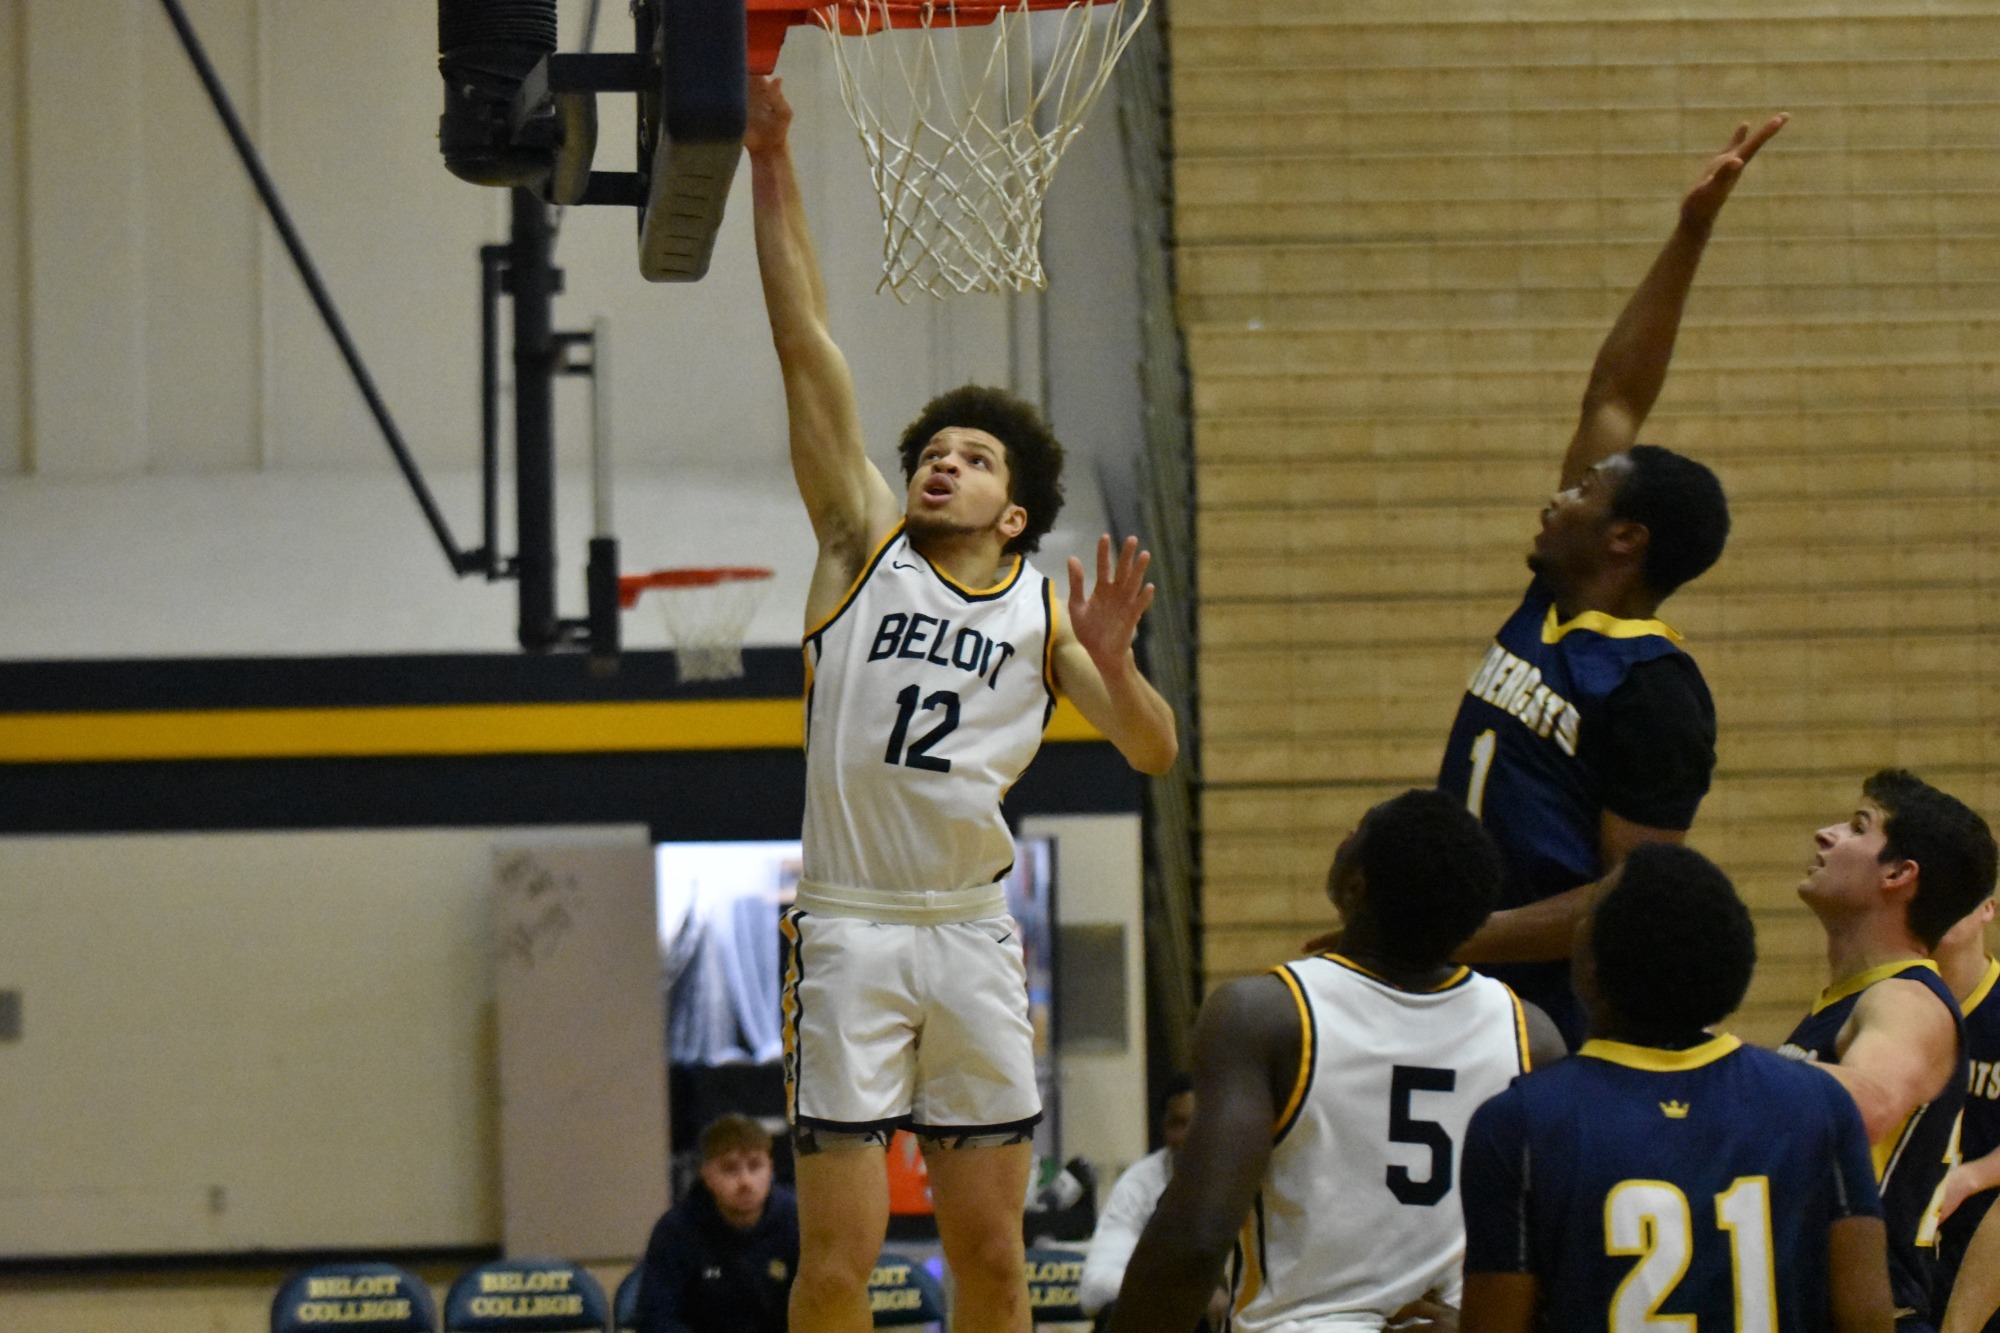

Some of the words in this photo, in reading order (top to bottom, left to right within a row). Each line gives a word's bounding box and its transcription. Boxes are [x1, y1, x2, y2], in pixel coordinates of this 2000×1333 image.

[867, 612, 1015, 690] BELOIT
[884, 683, 960, 773] 12
[1466, 729, 1496, 819] 1
[1386, 1065, 1456, 1206] 5
[308, 1275, 401, 1298] BELOIT
[481, 1271, 573, 1293] BELOIT
[1604, 1175, 1779, 1333] 21
[297, 1298, 411, 1323] COLLEGE
[470, 1294, 583, 1318] COLLEGE
